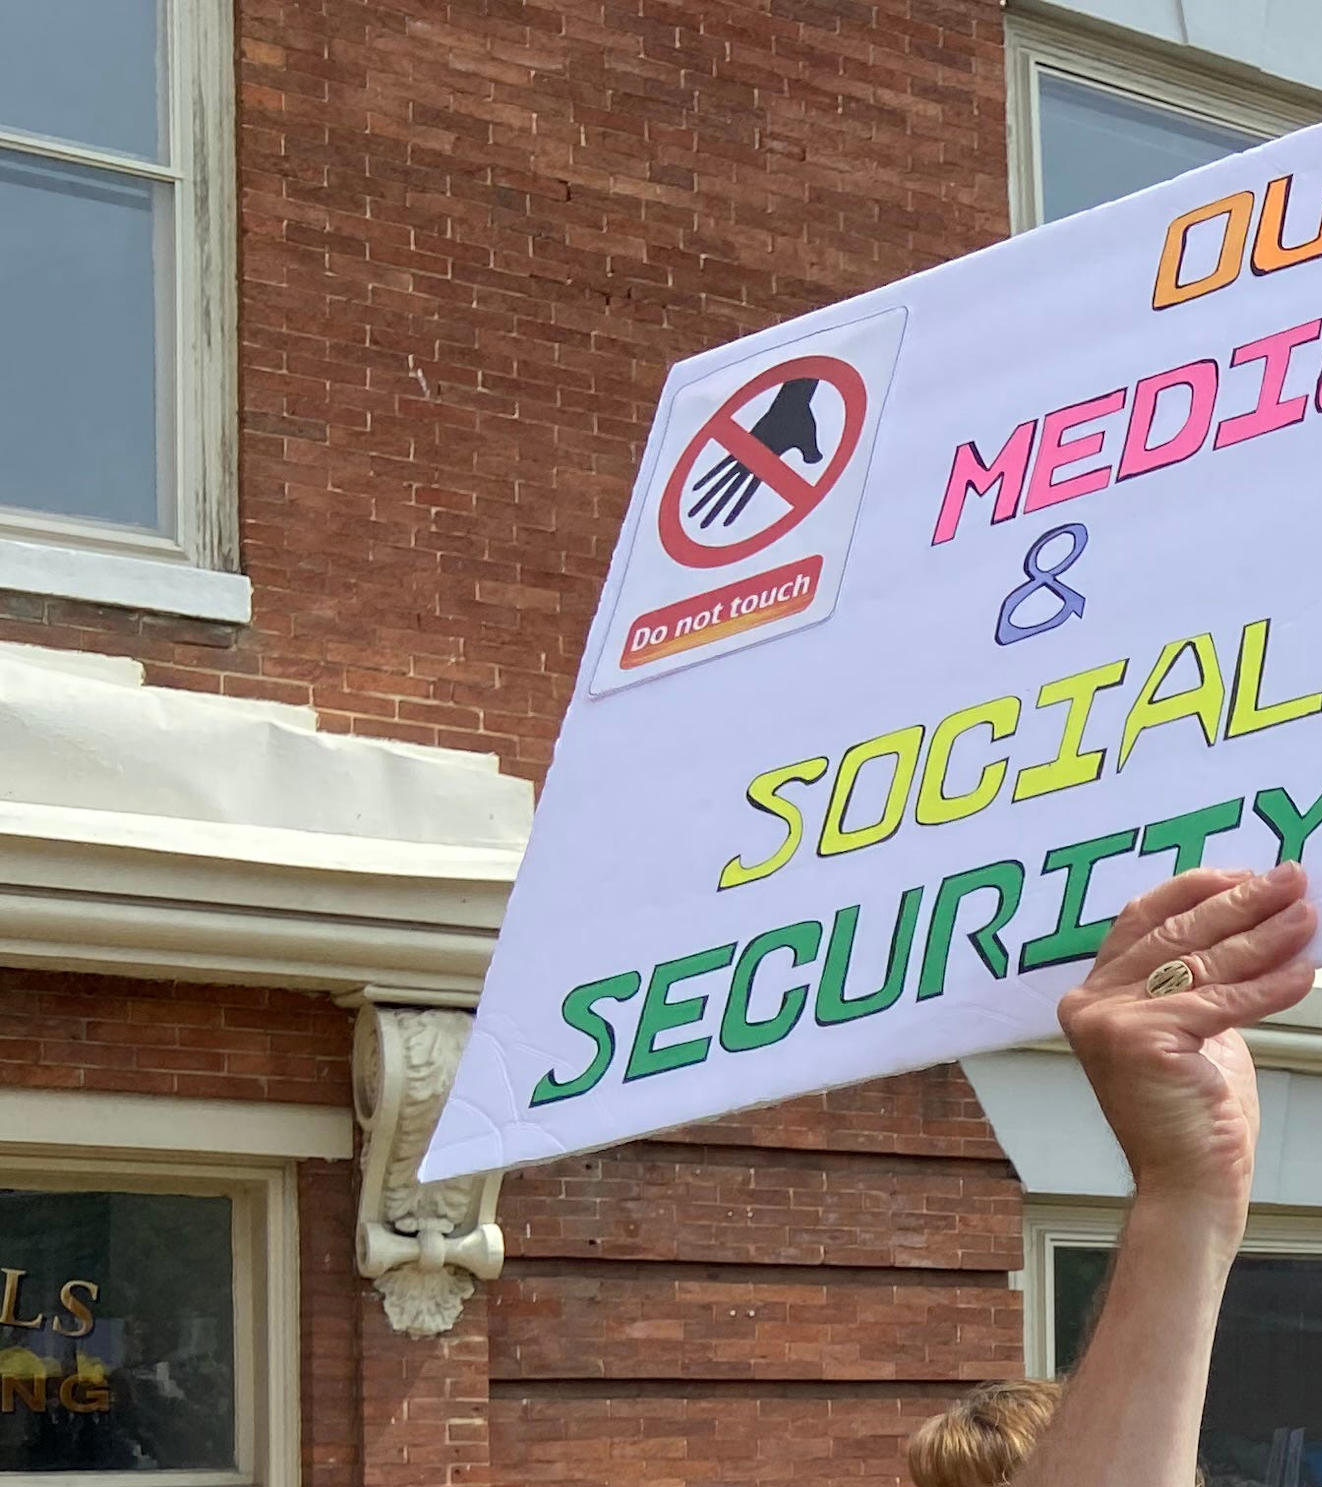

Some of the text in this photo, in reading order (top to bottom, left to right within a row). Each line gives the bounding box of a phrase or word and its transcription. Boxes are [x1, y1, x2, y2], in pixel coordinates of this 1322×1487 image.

[631, 573, 811, 652] Do not touch
[995, 523, 1088, 646] &
